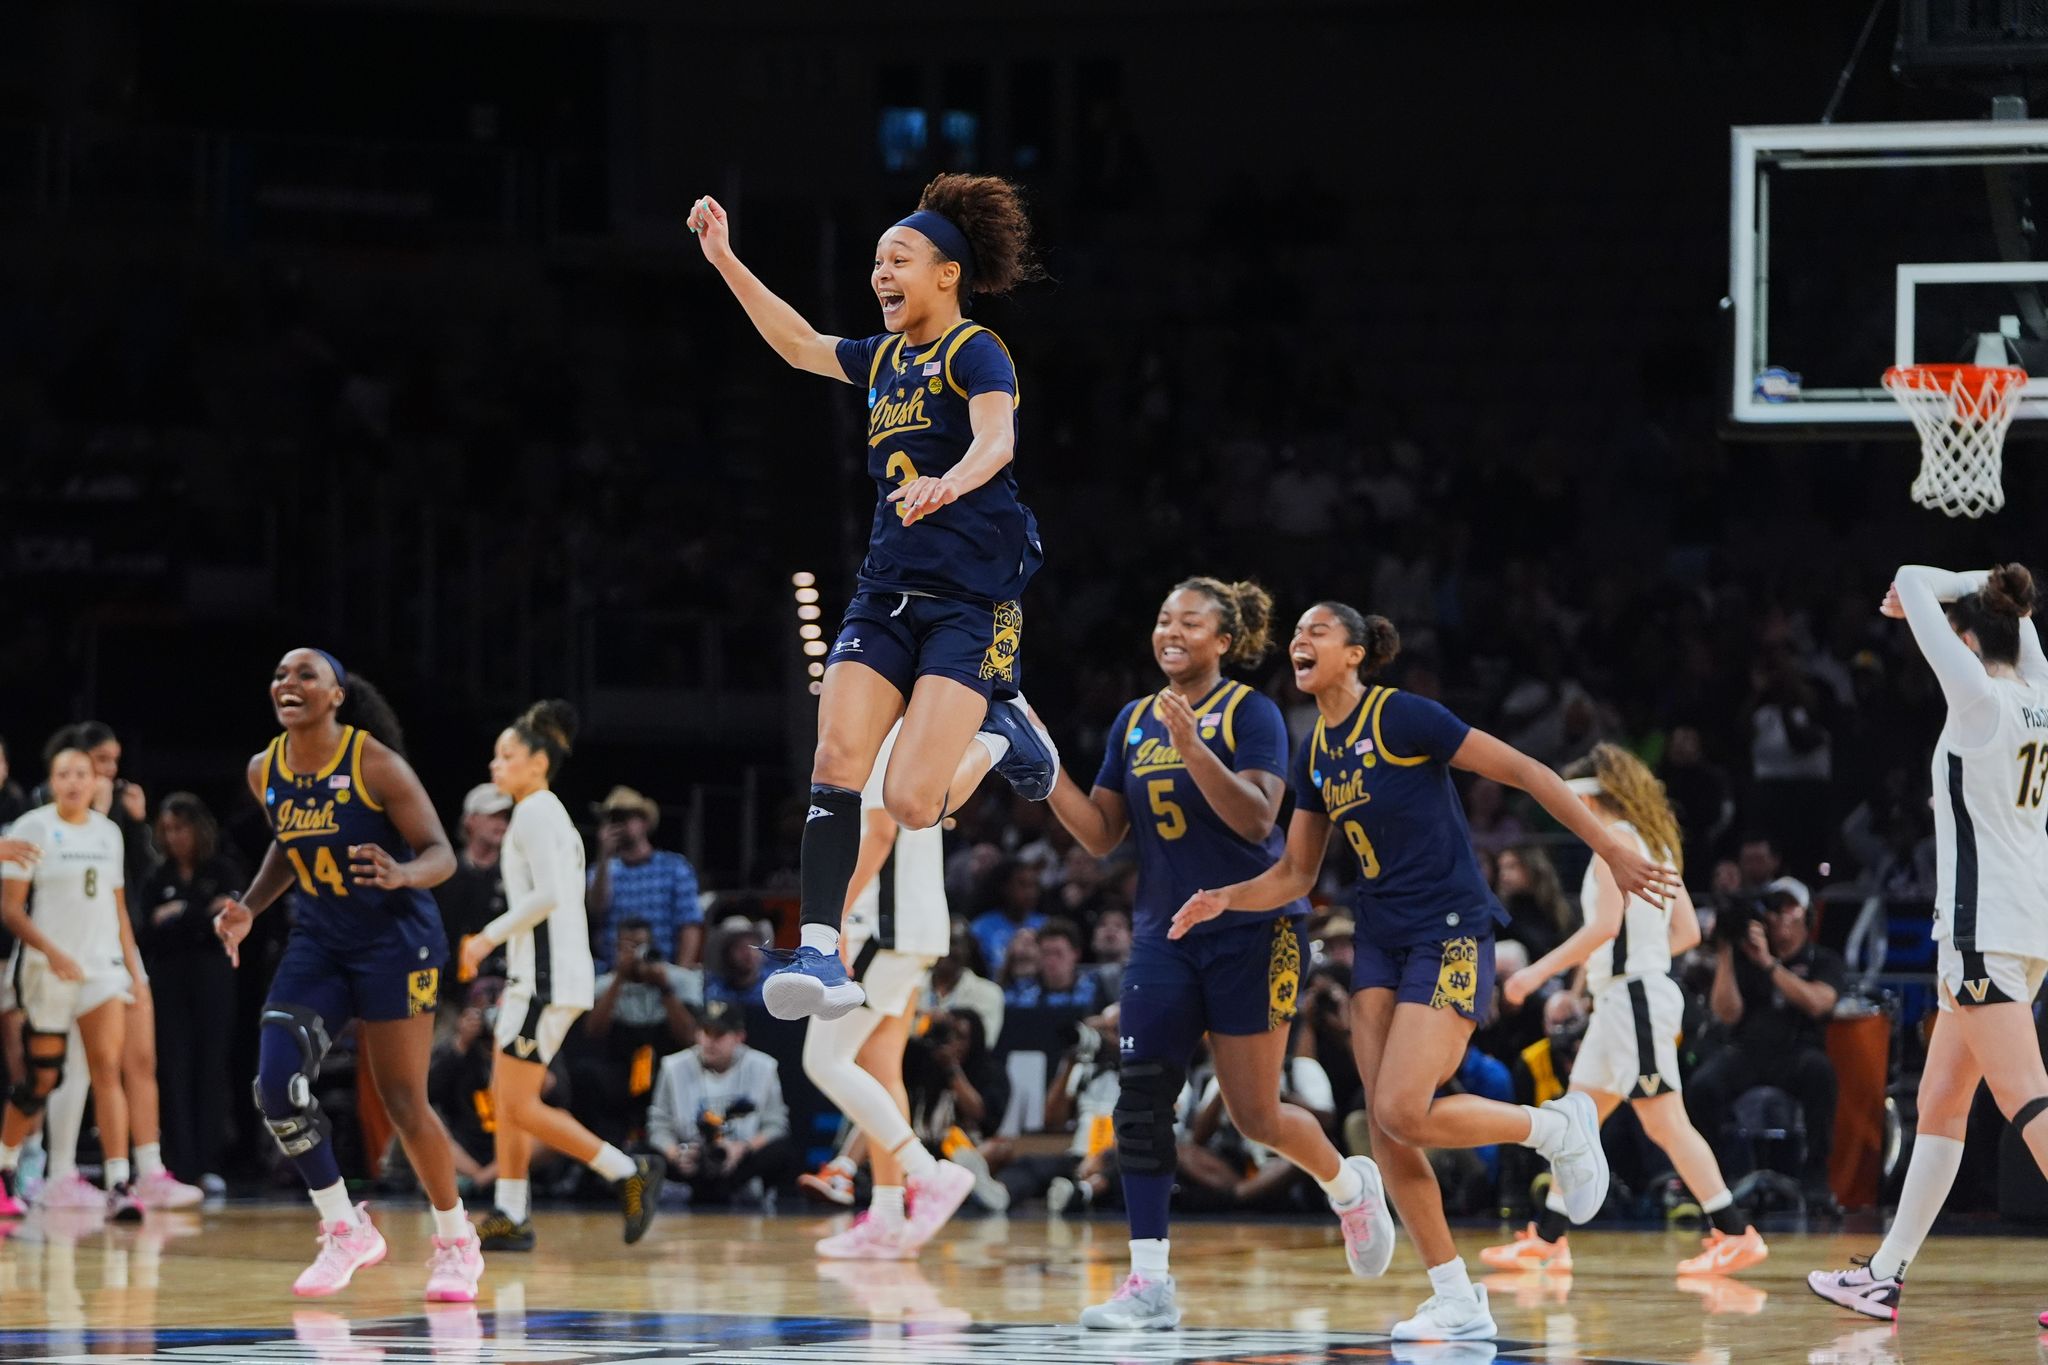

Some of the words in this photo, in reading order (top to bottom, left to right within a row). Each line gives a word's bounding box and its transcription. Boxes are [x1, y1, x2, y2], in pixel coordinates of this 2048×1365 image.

[868, 387, 931, 447] Irish
[1132, 738, 1186, 778] Iris
[2016, 741, 2048, 808] 13
[277, 799, 339, 842] Irish
[1147, 778, 1187, 841] 5
[1322, 768, 1371, 822] Irish
[287, 845, 349, 897] 14
[1344, 820, 1380, 879] 8
[84, 867, 97, 898] 8
[1963, 977, 1990, 1003] V
